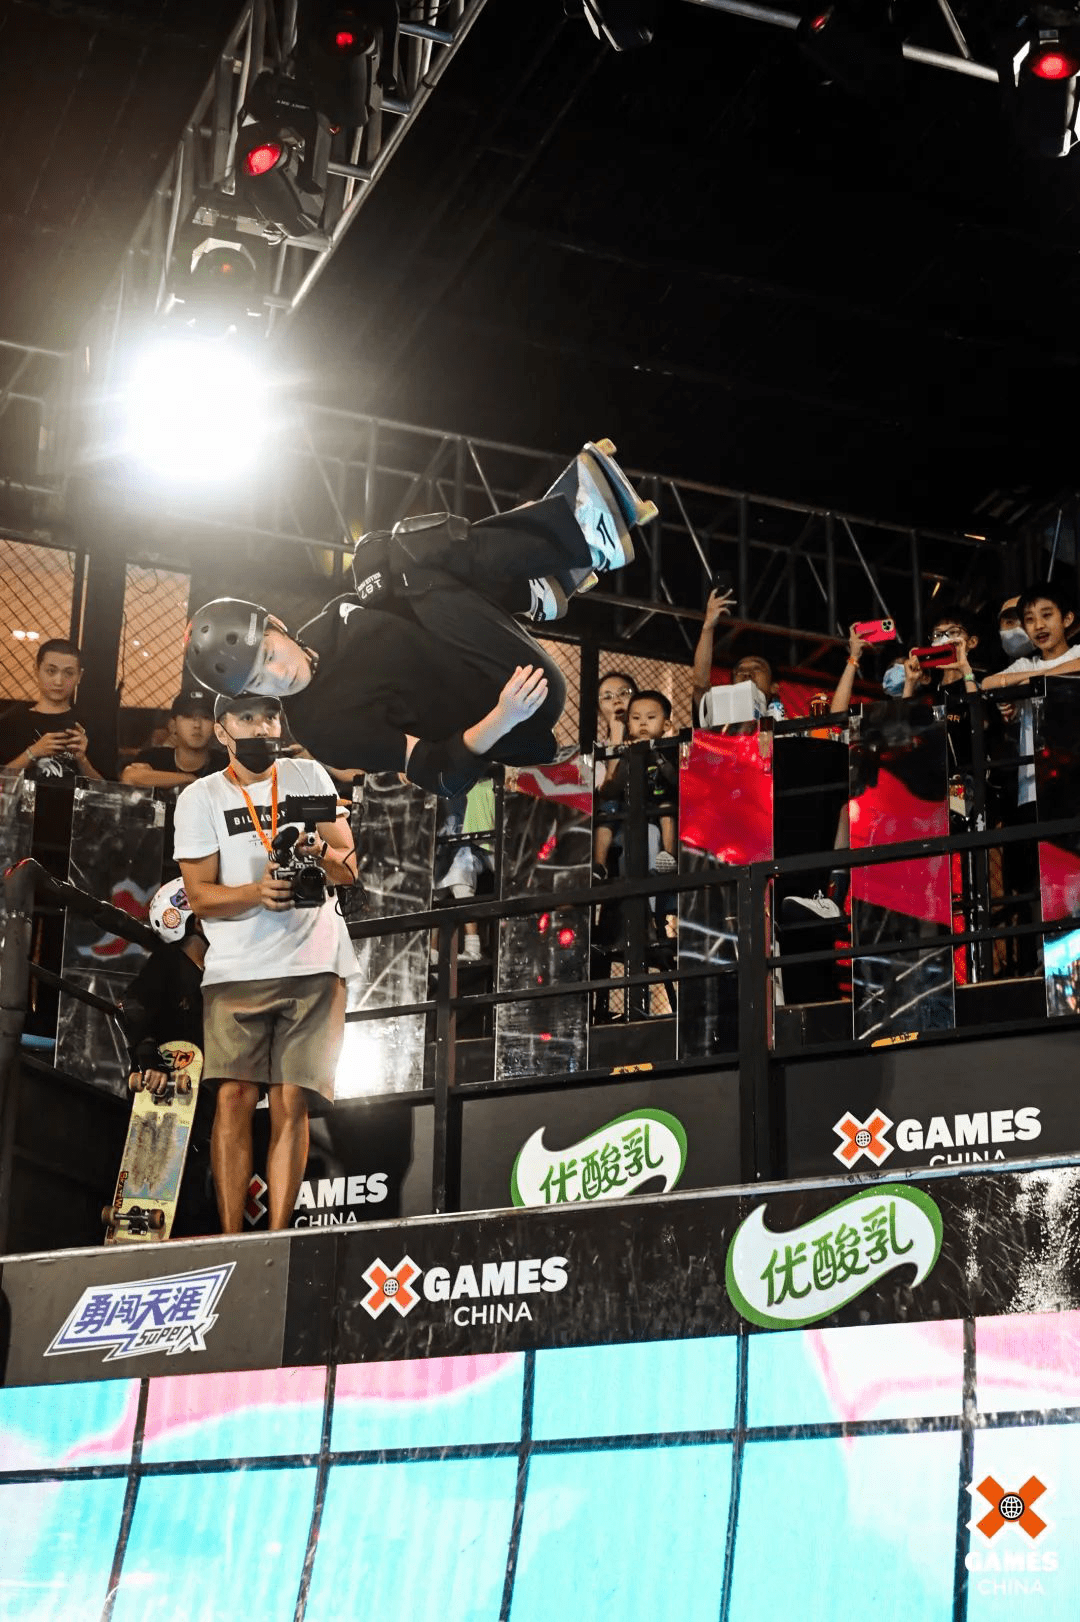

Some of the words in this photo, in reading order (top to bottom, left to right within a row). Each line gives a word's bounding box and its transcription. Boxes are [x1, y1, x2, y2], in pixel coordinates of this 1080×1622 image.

[895, 1106, 1042, 1152] GAMES
[539, 1123, 664, 1204] 优酸乳
[293, 1172, 389, 1210] AMES
[760, 1201, 914, 1307] 优酸乳
[422, 1256, 569, 1302] GAMES
[74, 1285, 206, 1334] 勇闯天涯
[453, 1301, 533, 1327] CHINA
